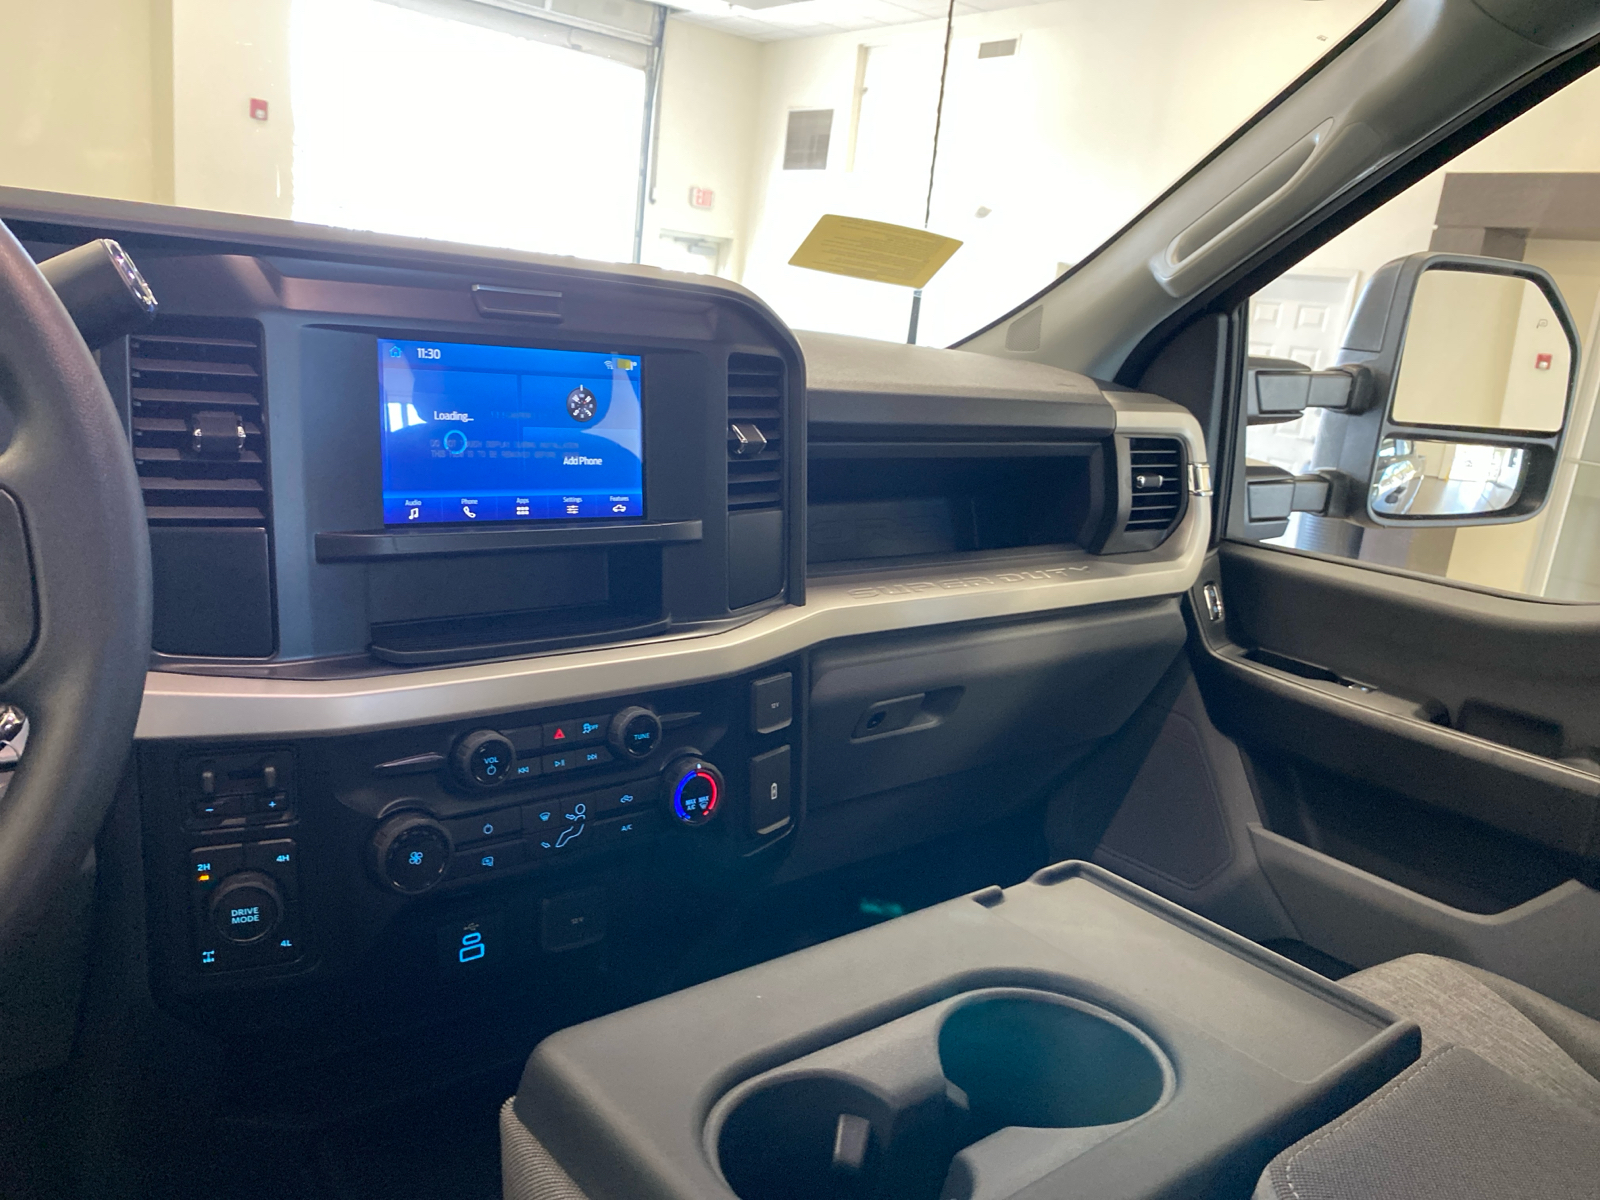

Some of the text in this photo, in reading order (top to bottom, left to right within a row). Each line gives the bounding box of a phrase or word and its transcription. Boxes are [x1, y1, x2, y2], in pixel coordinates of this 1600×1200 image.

[416, 347, 441, 360] 11:30
[563, 456, 603, 466] Add Phone
[562, 496, 583, 504] Settings
[848, 576, 995, 599] SUPER
[633, 731, 651, 741] TUNE
[483, 756, 499, 765] VOL
[620, 823, 634, 832] A/C
[276, 854, 290, 862] 4H
[197, 863, 211, 872] 2H
[231, 906, 259, 917] DRIVE
[231, 914, 260, 924] MODE
[280, 939, 292, 947] 4L
